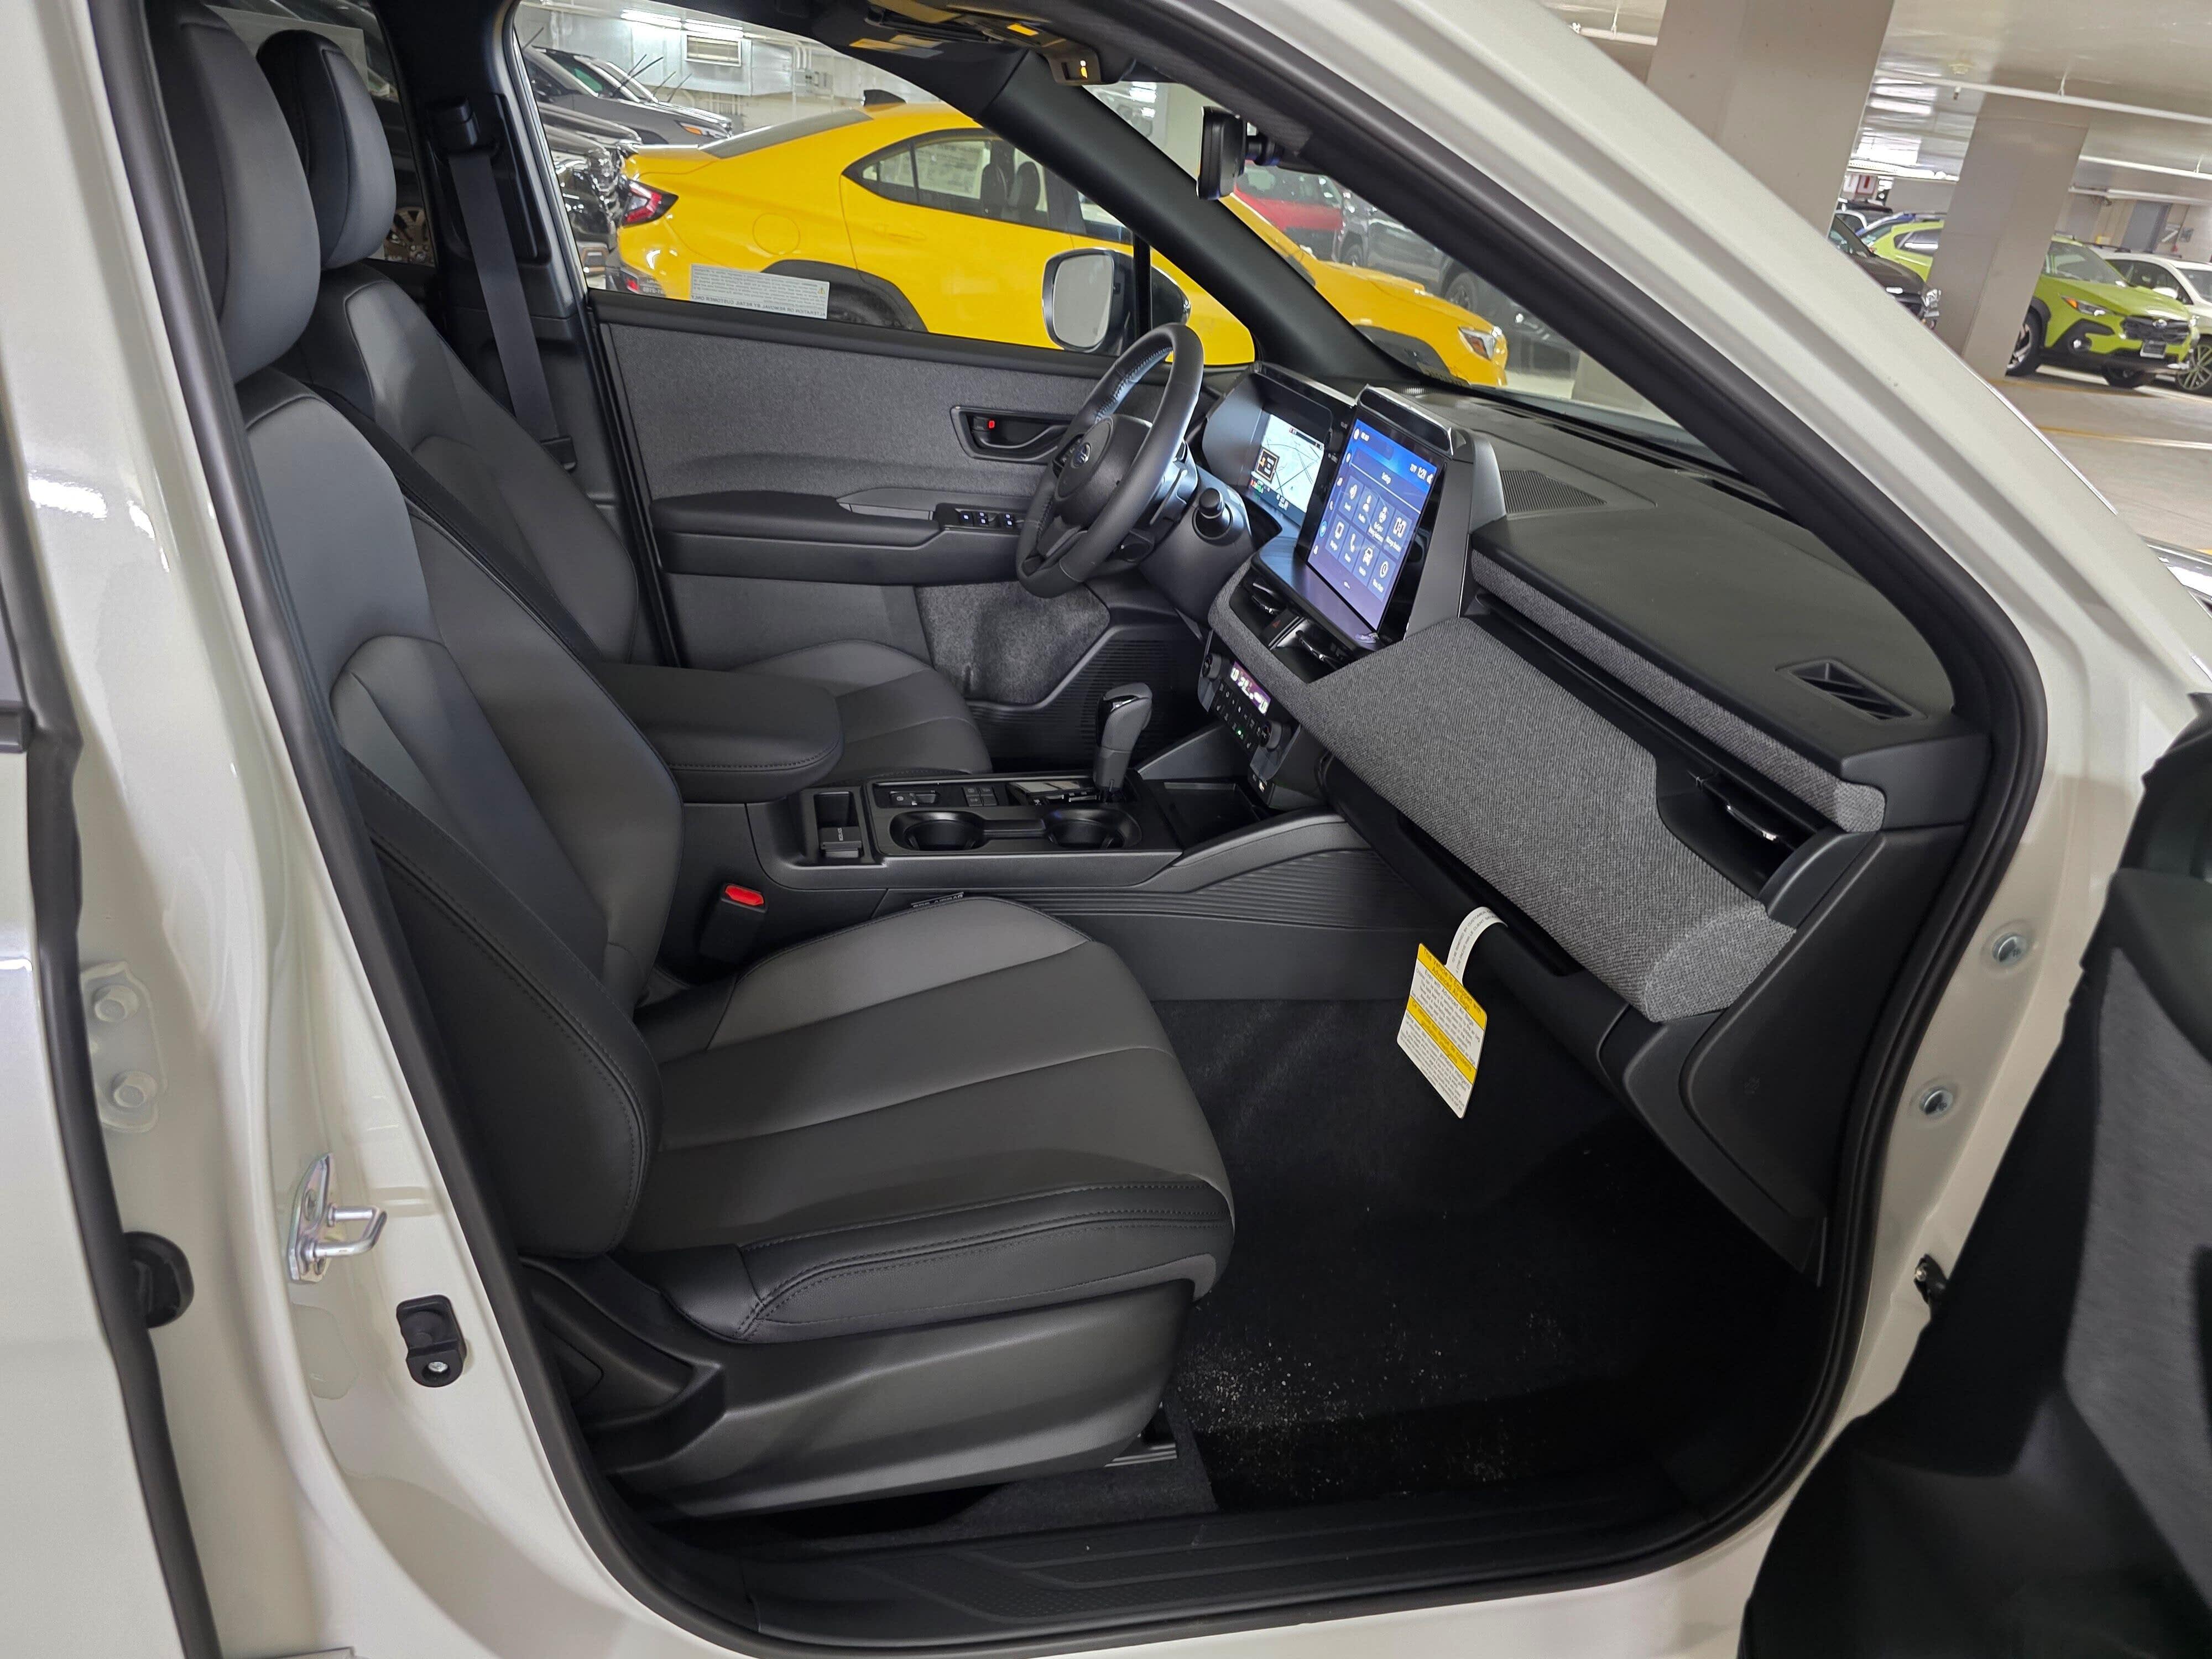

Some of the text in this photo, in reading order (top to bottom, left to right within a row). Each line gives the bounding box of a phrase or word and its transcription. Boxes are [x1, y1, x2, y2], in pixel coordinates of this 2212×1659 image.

[1432, 965, 1452, 990] Advanced
[1433, 958, 1448, 978] Vehicle
[1453, 980, 1473, 1005] Equipped
